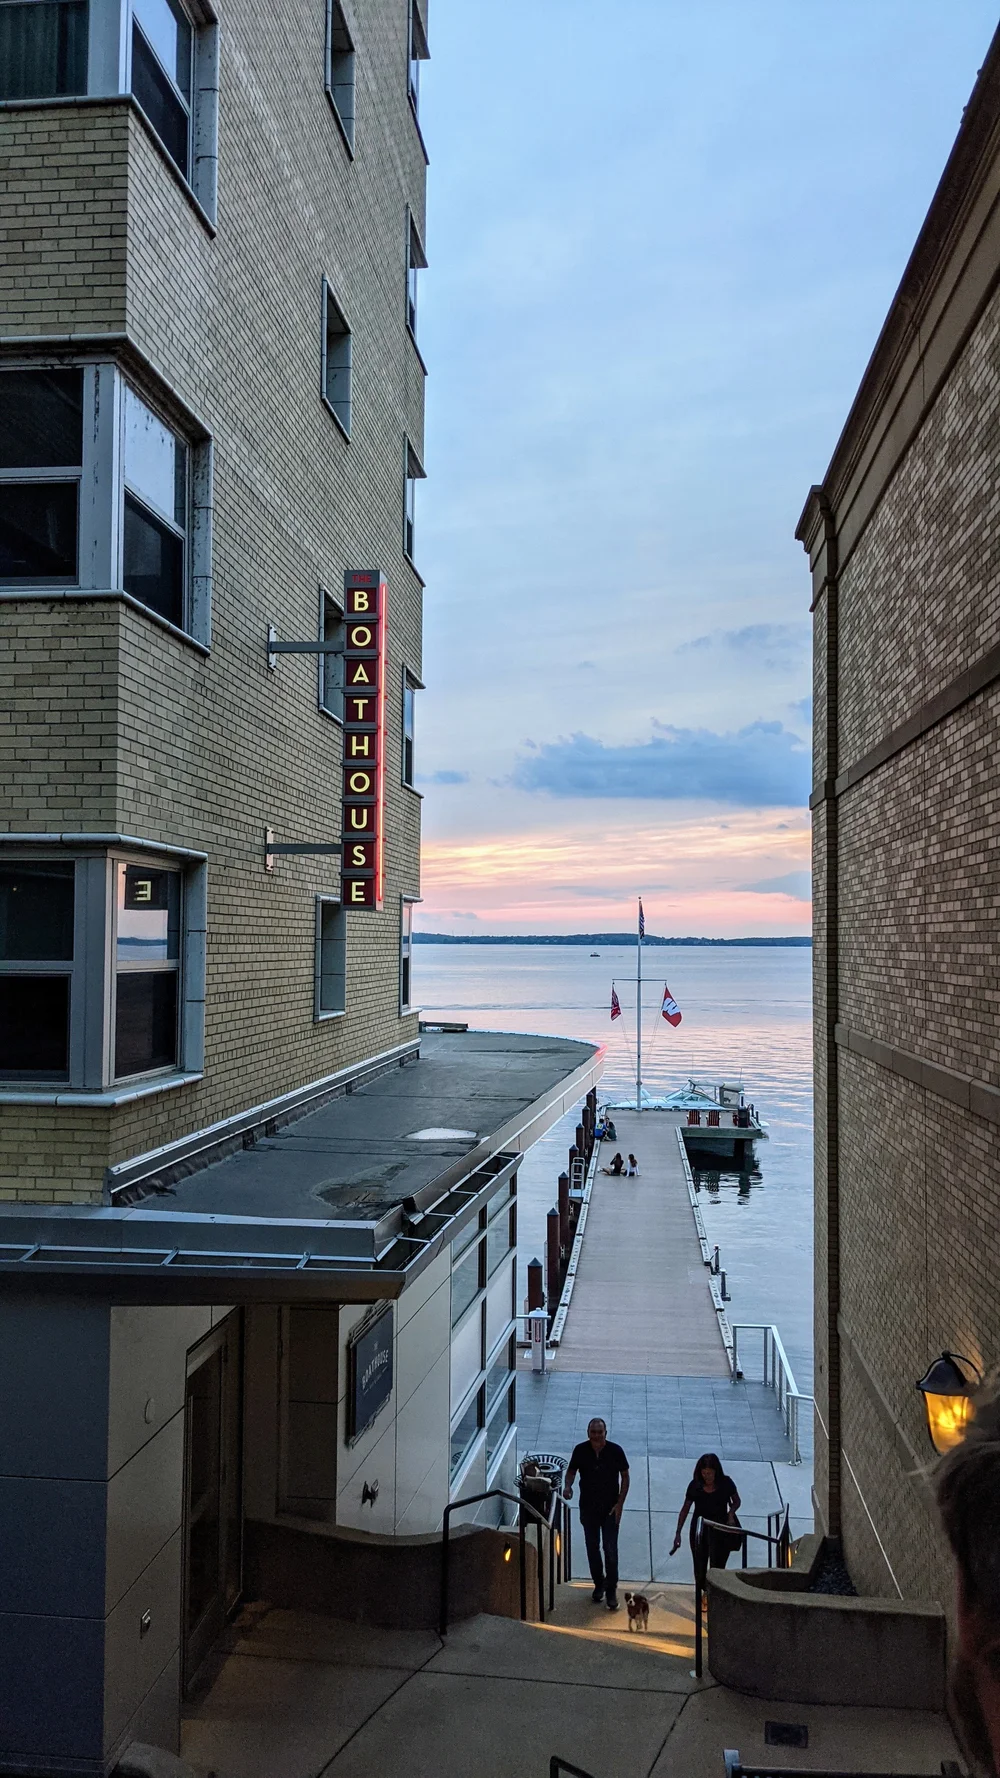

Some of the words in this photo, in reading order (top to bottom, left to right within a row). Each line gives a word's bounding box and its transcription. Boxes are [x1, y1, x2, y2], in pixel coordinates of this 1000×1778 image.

[352, 574, 372, 583] THE
[350, 590, 372, 902] BOATHOUSE
[362, 1349, 389, 1390] BOATHOUSE
